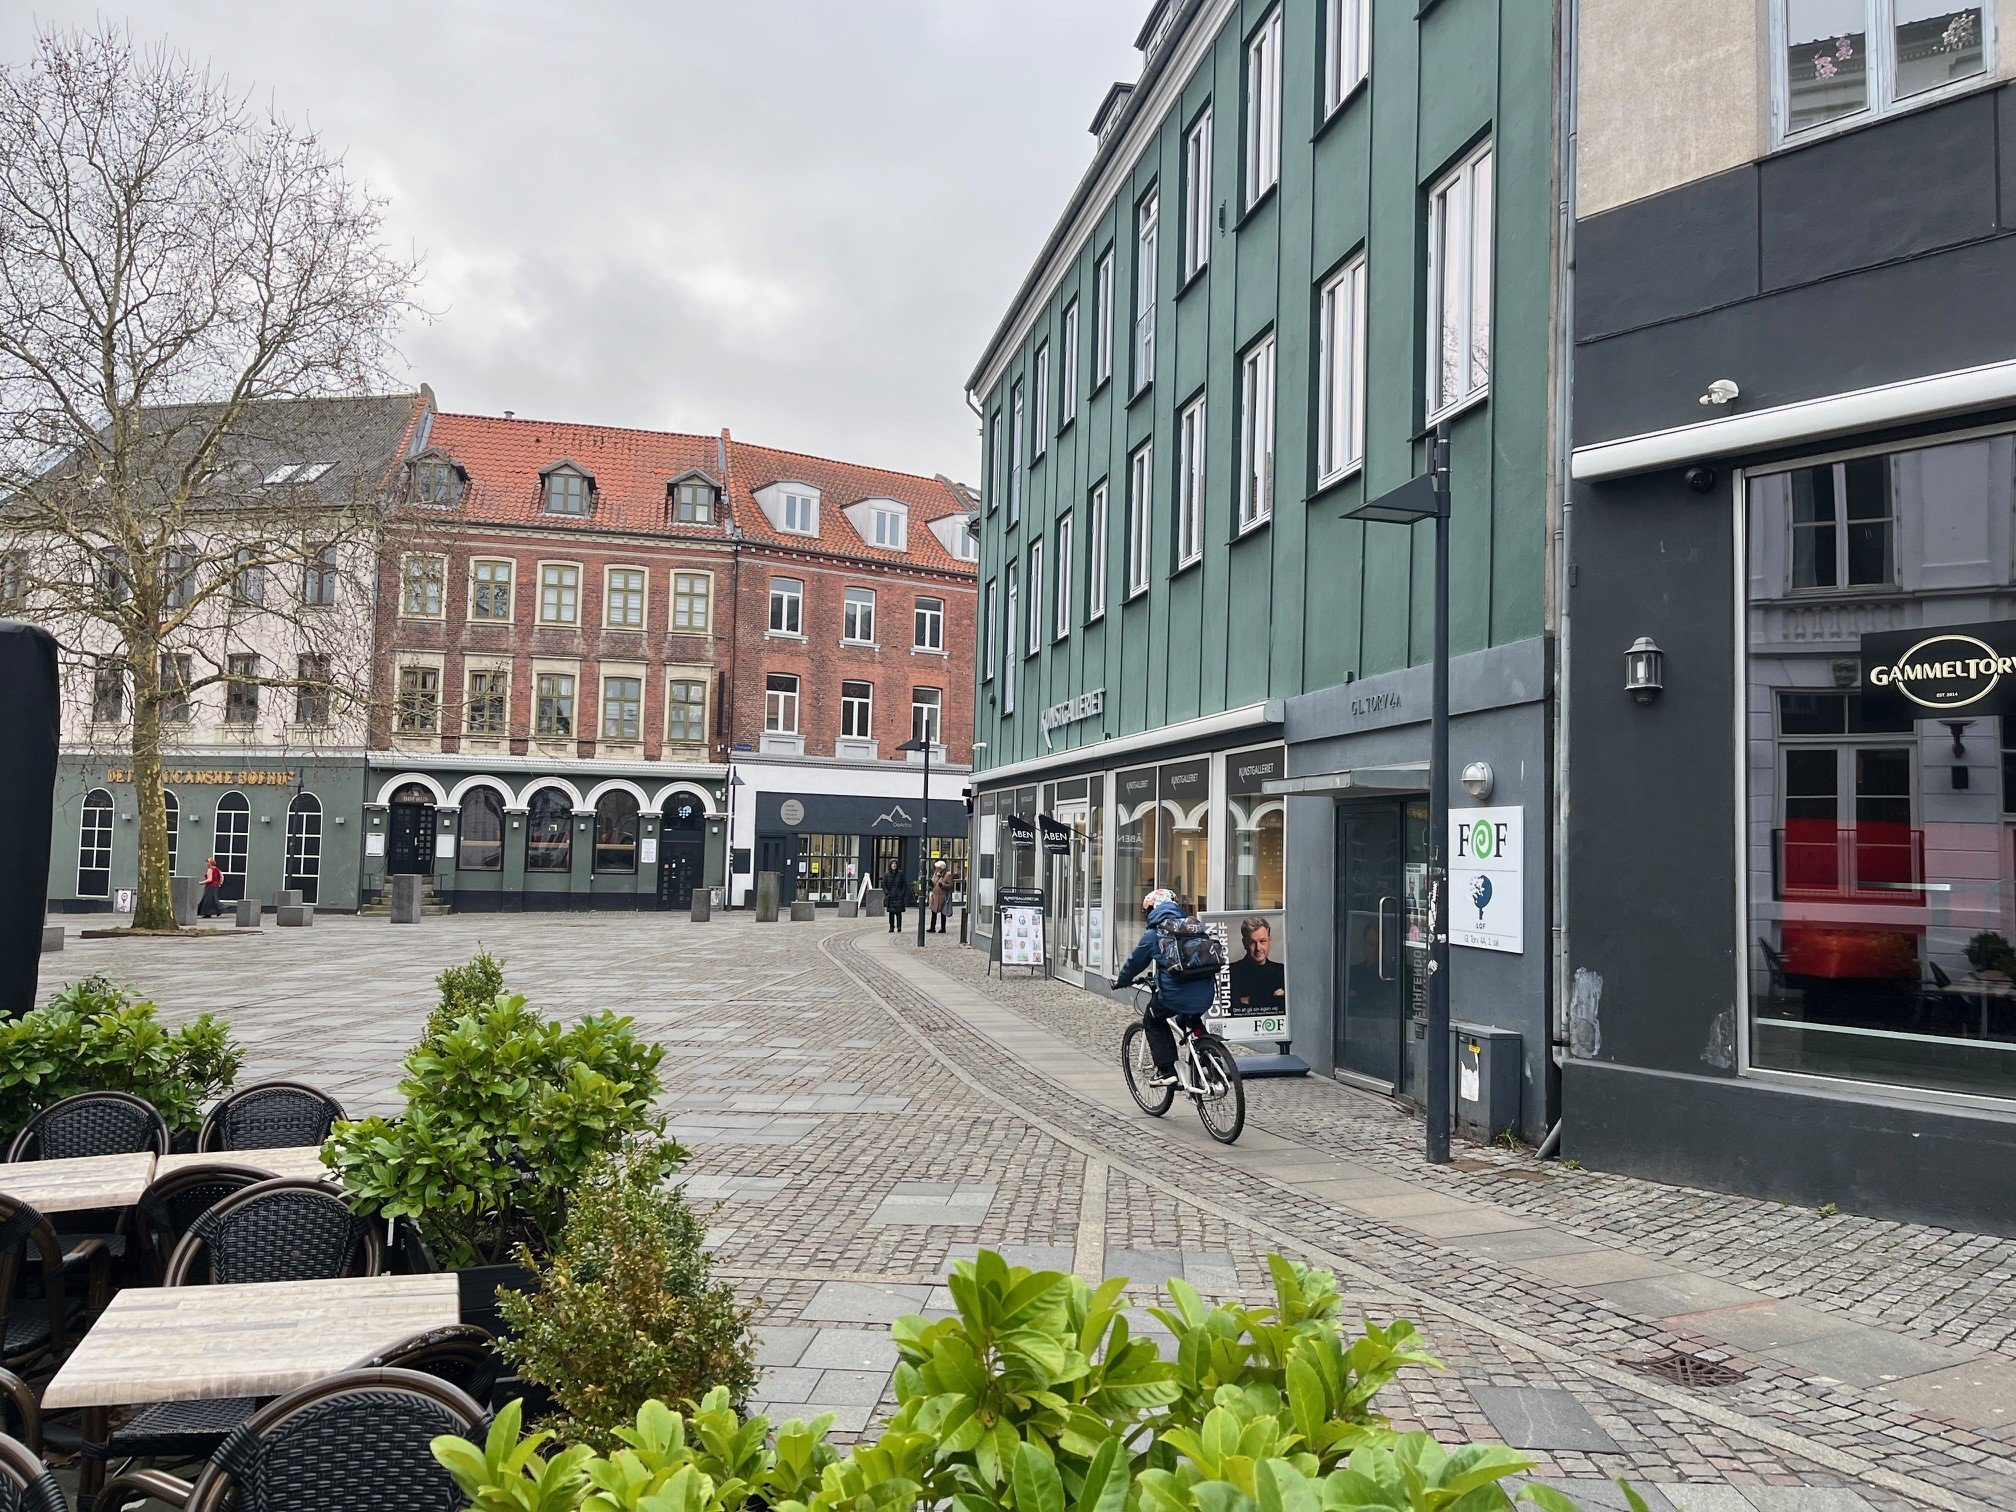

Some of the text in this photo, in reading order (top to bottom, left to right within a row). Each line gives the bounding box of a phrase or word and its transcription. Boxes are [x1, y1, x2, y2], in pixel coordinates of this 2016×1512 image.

[1041, 688, 1106, 748] KUNSTGALLERIET
[1171, 773, 1199, 791] KUNSTGALLERIET
[1239, 763, 1275, 783] KUNSTGALLERIET
[1011, 827, 1034, 839] ÅBEN
[1043, 829, 1068, 841] ÅBEN
[1457, 819, 1508, 859] FOF
[1254, 1018, 1285, 1032] FOF
